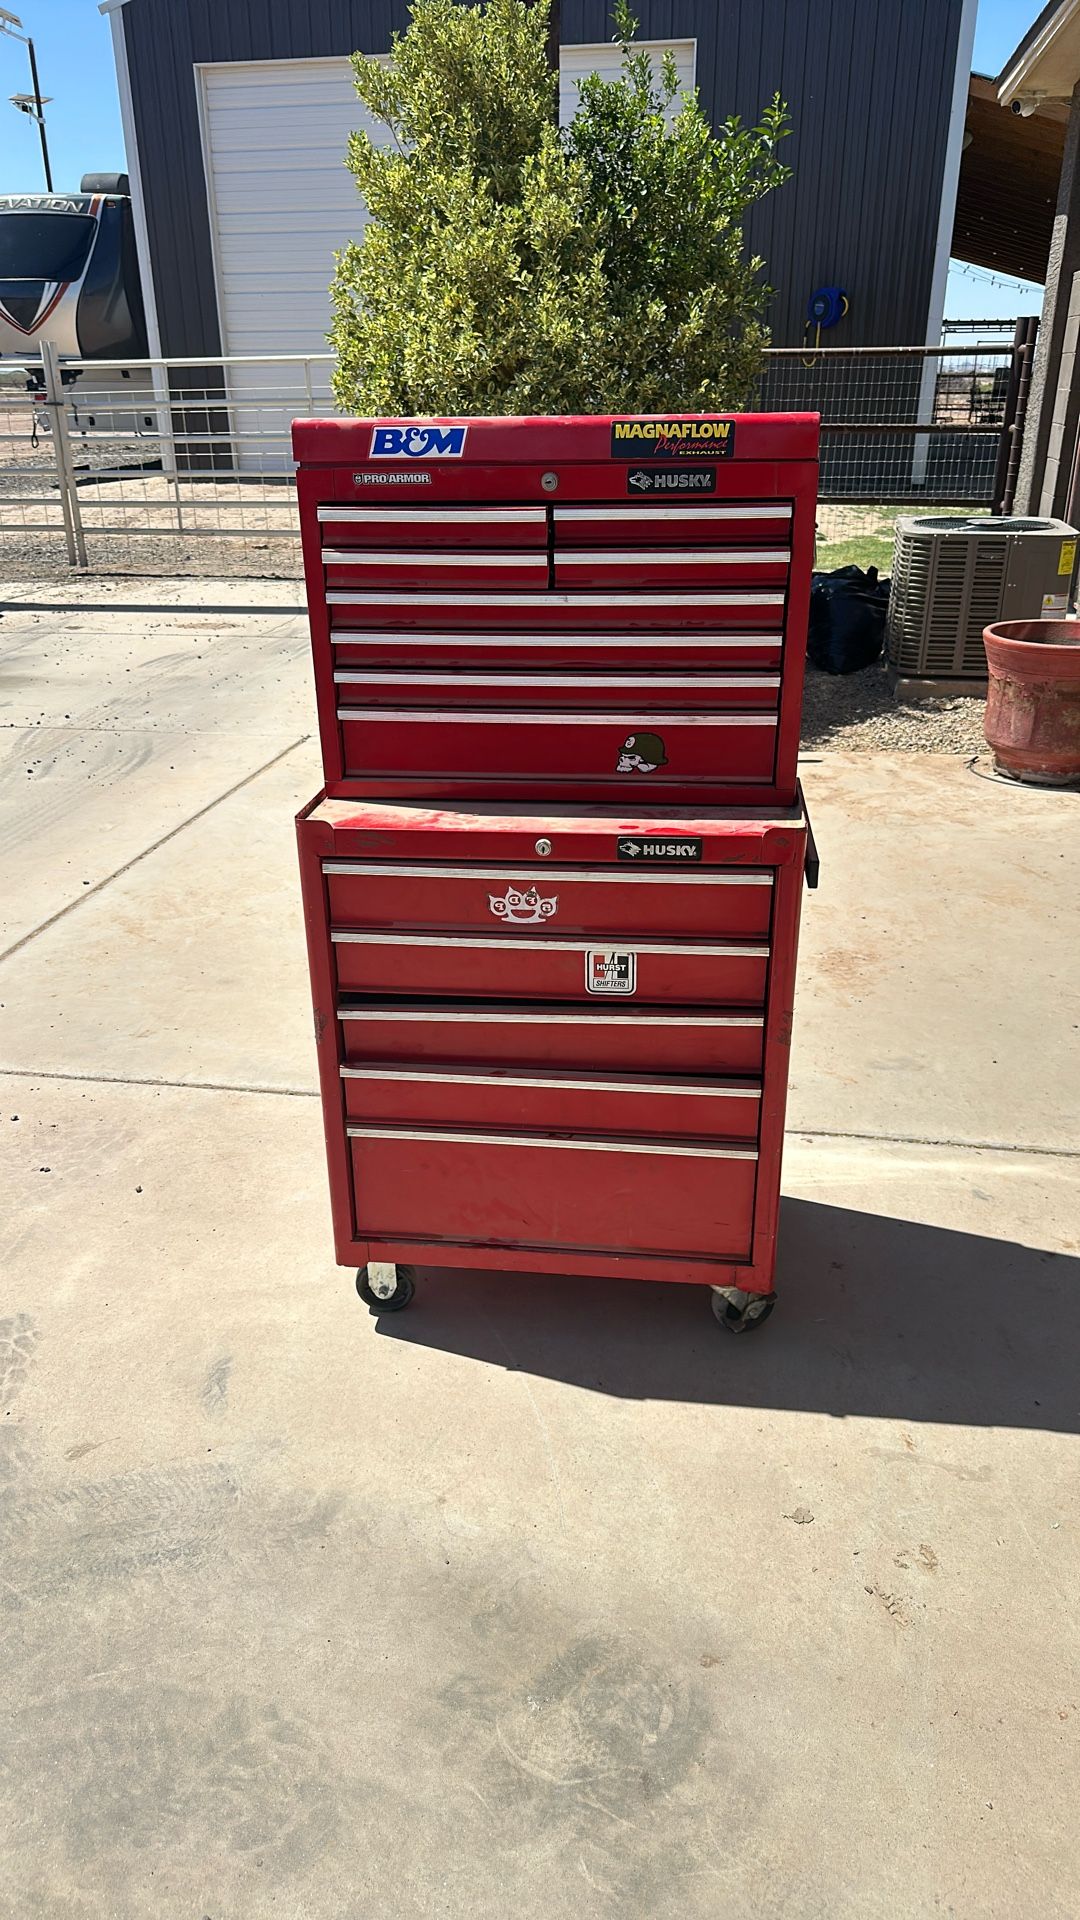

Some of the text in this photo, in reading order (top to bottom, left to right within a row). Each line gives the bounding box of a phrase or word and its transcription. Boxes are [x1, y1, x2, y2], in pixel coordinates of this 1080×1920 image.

[615, 423, 730, 439] MAGNAFLOW
[371, 427, 465, 456] B&M
[654, 434, 728, 456] Performance
[364, 474, 429, 483] PRO ARMOR
[596, 963, 627, 971] HURST
[595, 979, 627, 988] SHIFTERS
